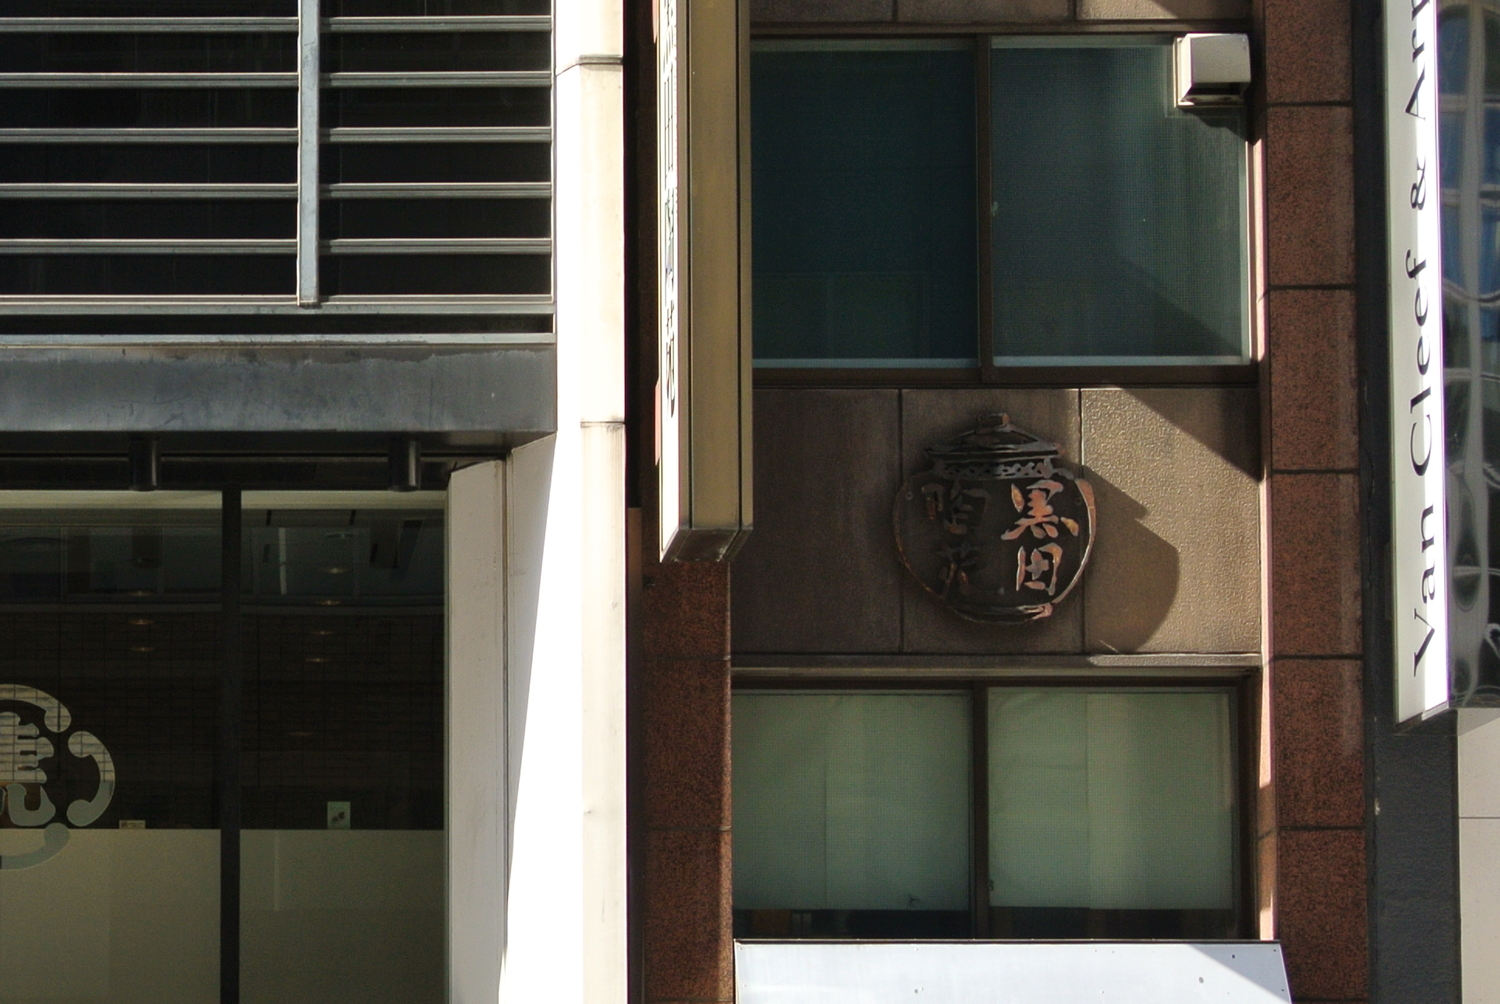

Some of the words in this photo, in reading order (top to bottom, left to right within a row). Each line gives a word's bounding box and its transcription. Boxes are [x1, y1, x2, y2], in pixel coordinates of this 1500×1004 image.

[1410, 156, 1426, 211] &
[1405, 249, 1432, 477] Cleef
[1413, 504, 1436, 677] Van
